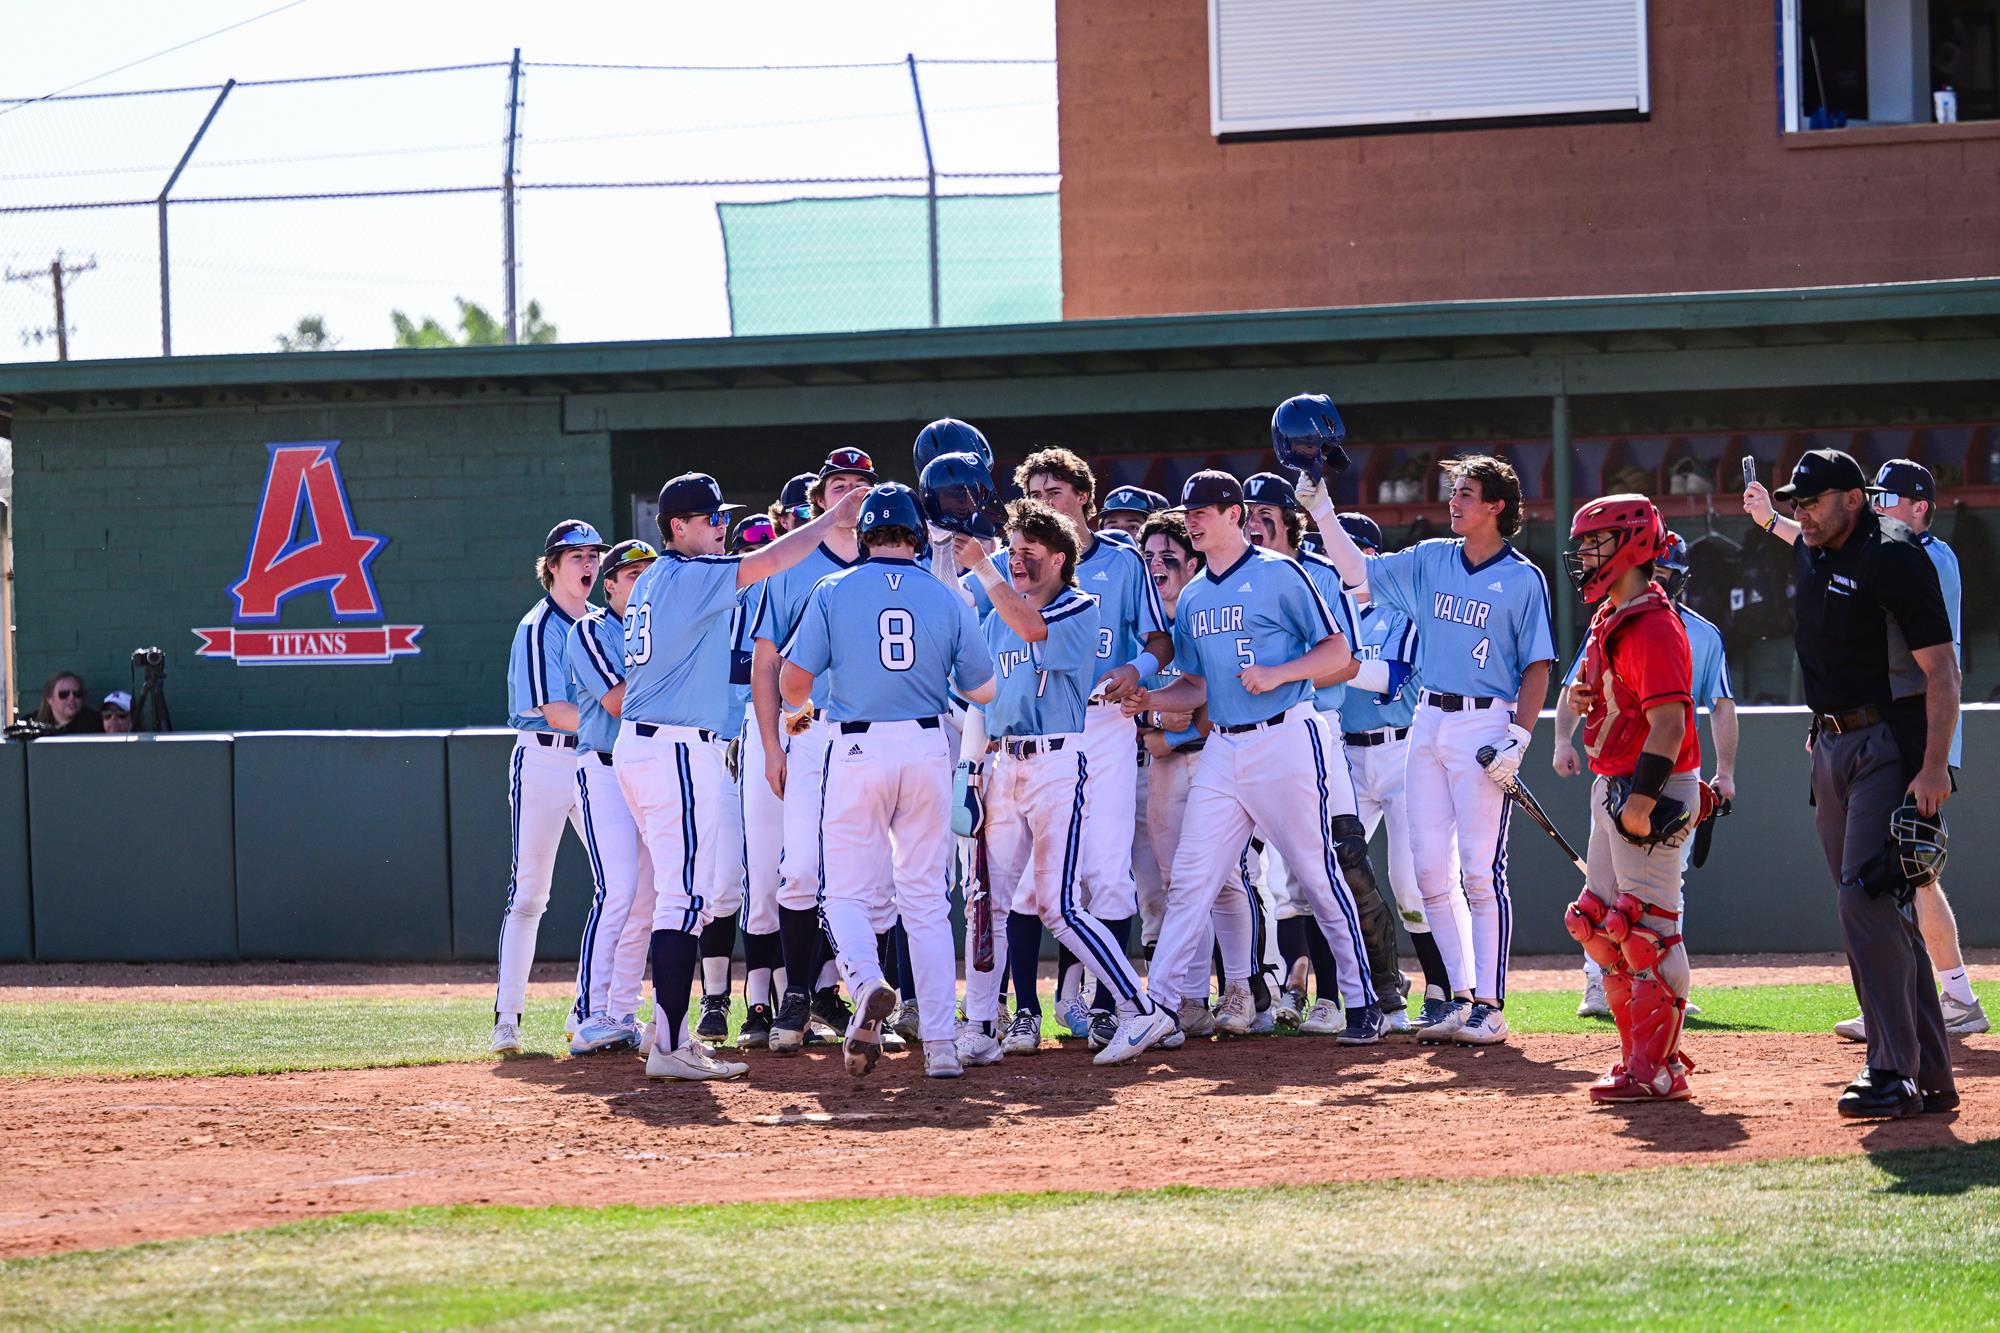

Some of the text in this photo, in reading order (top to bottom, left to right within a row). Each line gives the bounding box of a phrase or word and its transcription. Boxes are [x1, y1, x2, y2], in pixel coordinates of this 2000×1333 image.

[1184, 482, 1195, 500] V
[1250, 480, 1264, 497] V
[883, 509, 890, 519] 8
[884, 572, 904, 591] V
[1191, 605, 1243, 639] VALOR
[1434, 592, 1491, 629] VALOR
[268, 633, 347, 656] TITANS
[878, 607, 916, 672] 8
[1235, 637, 1256, 669] 5
[1471, 637, 1490, 669] 4
[1902, 1077, 1918, 1097] N
